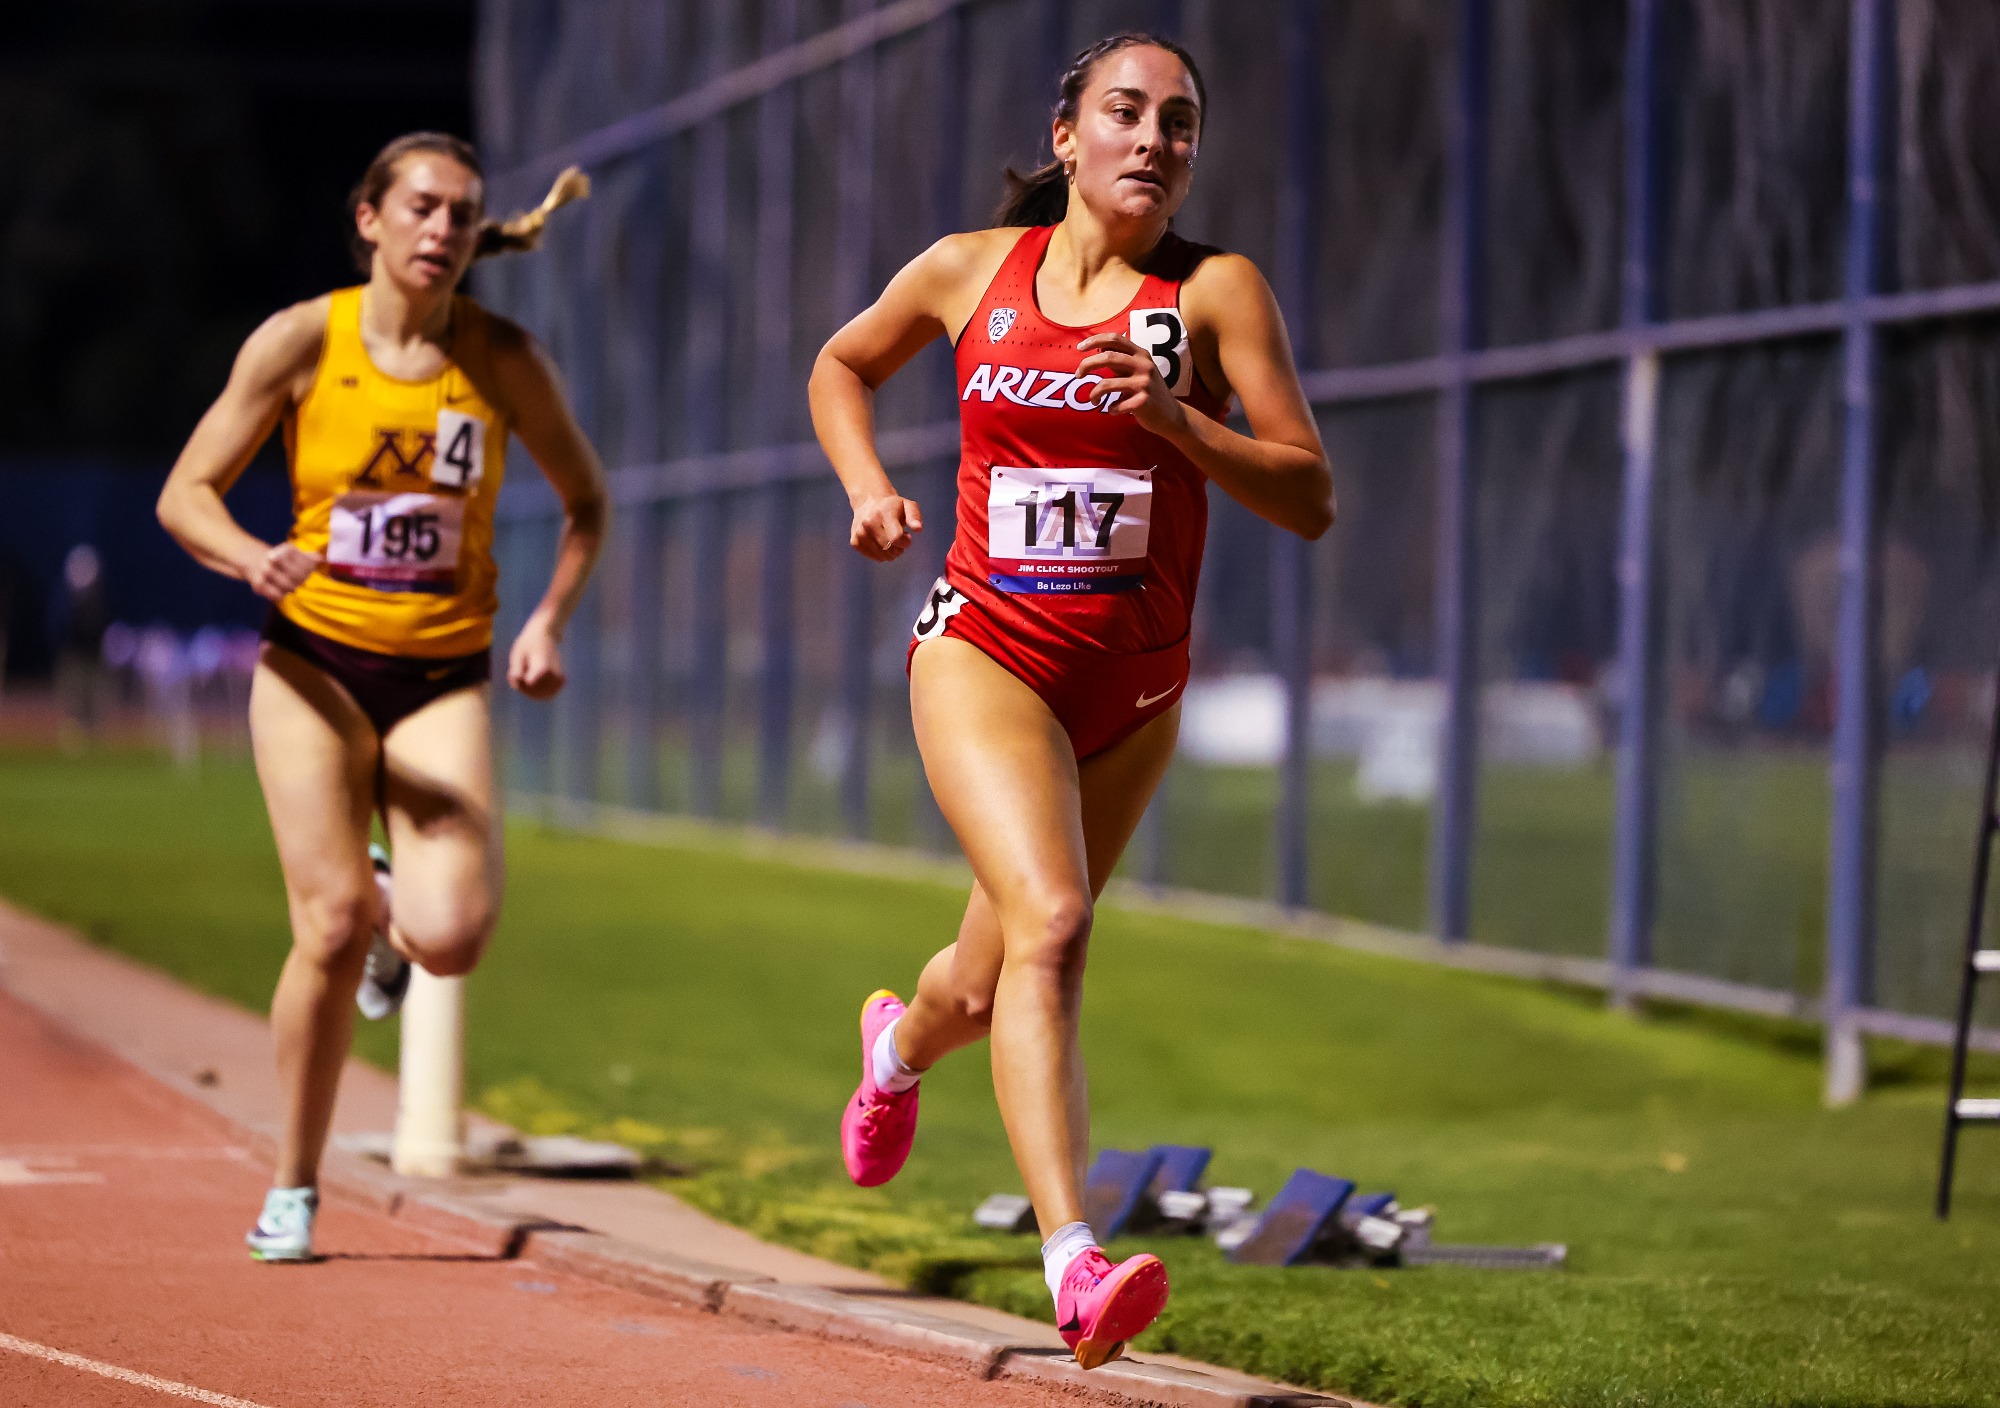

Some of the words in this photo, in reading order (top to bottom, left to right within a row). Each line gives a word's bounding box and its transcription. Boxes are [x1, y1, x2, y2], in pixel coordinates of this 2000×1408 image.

[1146, 313, 1182, 389] 3
[961, 363, 1123, 414] ARIZO
[445, 421, 473, 485] 4
[357, 511, 440, 562] 195
[1014, 490, 1125, 548] 117
[1036, 565, 1065, 573] CLICK
[1067, 565, 1119, 573] SHOOTOUT
[1037, 582, 1048, 590] Be
[1050, 582, 1071, 590] Lezo
[1073, 582, 1091, 590] Like
